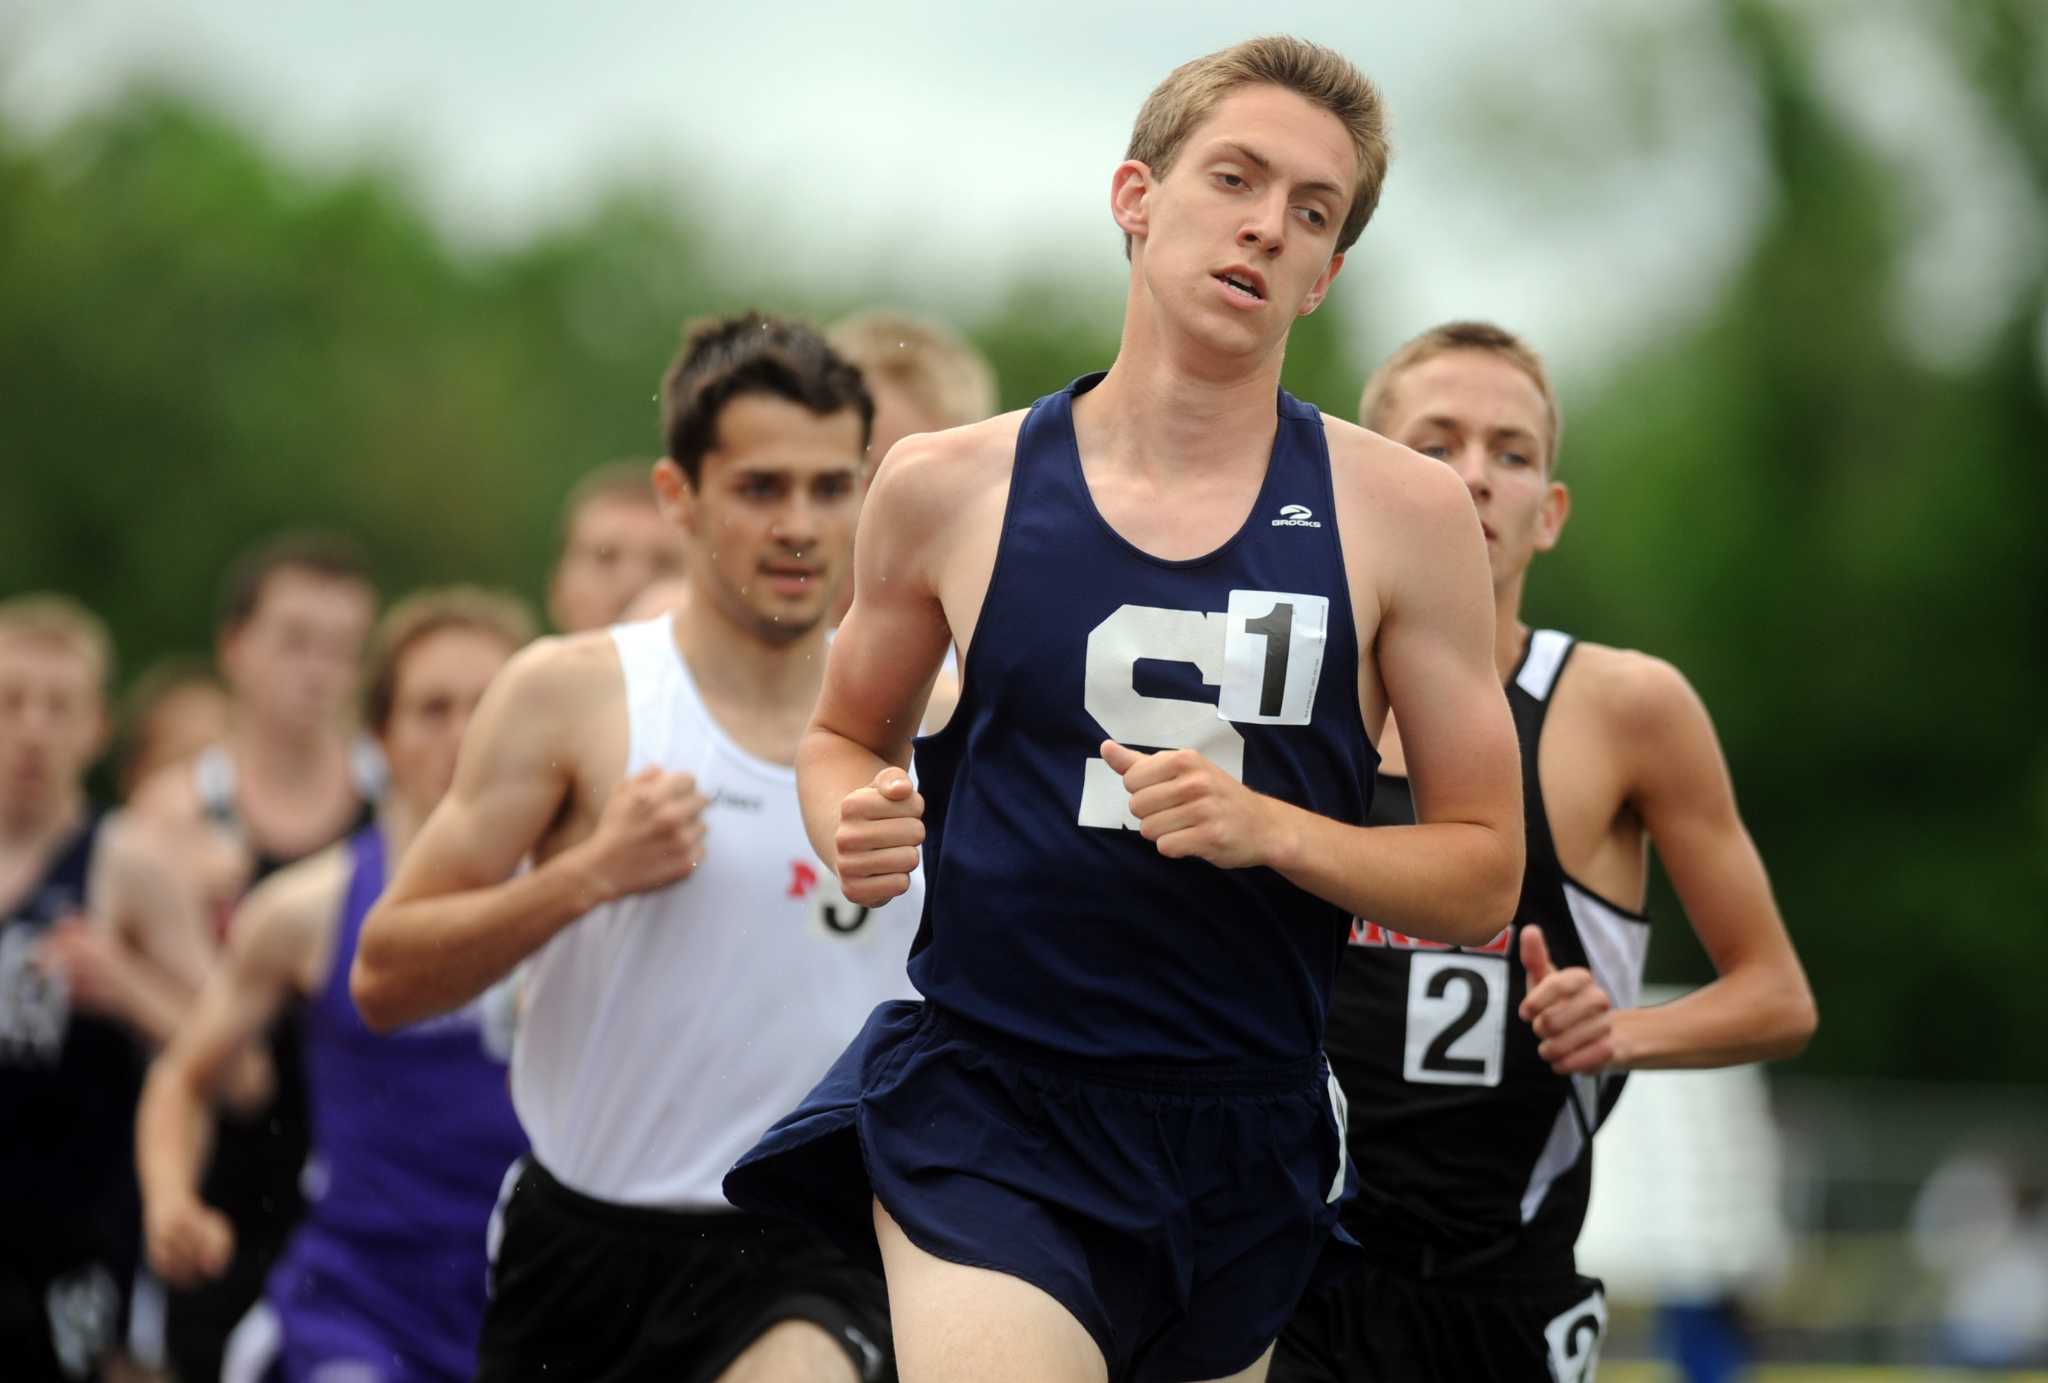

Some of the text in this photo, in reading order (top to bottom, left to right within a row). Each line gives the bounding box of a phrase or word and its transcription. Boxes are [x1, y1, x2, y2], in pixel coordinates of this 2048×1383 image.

[1271, 519, 1321, 528] BROOKS
[1245, 602, 1293, 717] 1
[1078, 604, 1245, 832] S
[1421, 967, 1489, 1074] 2
